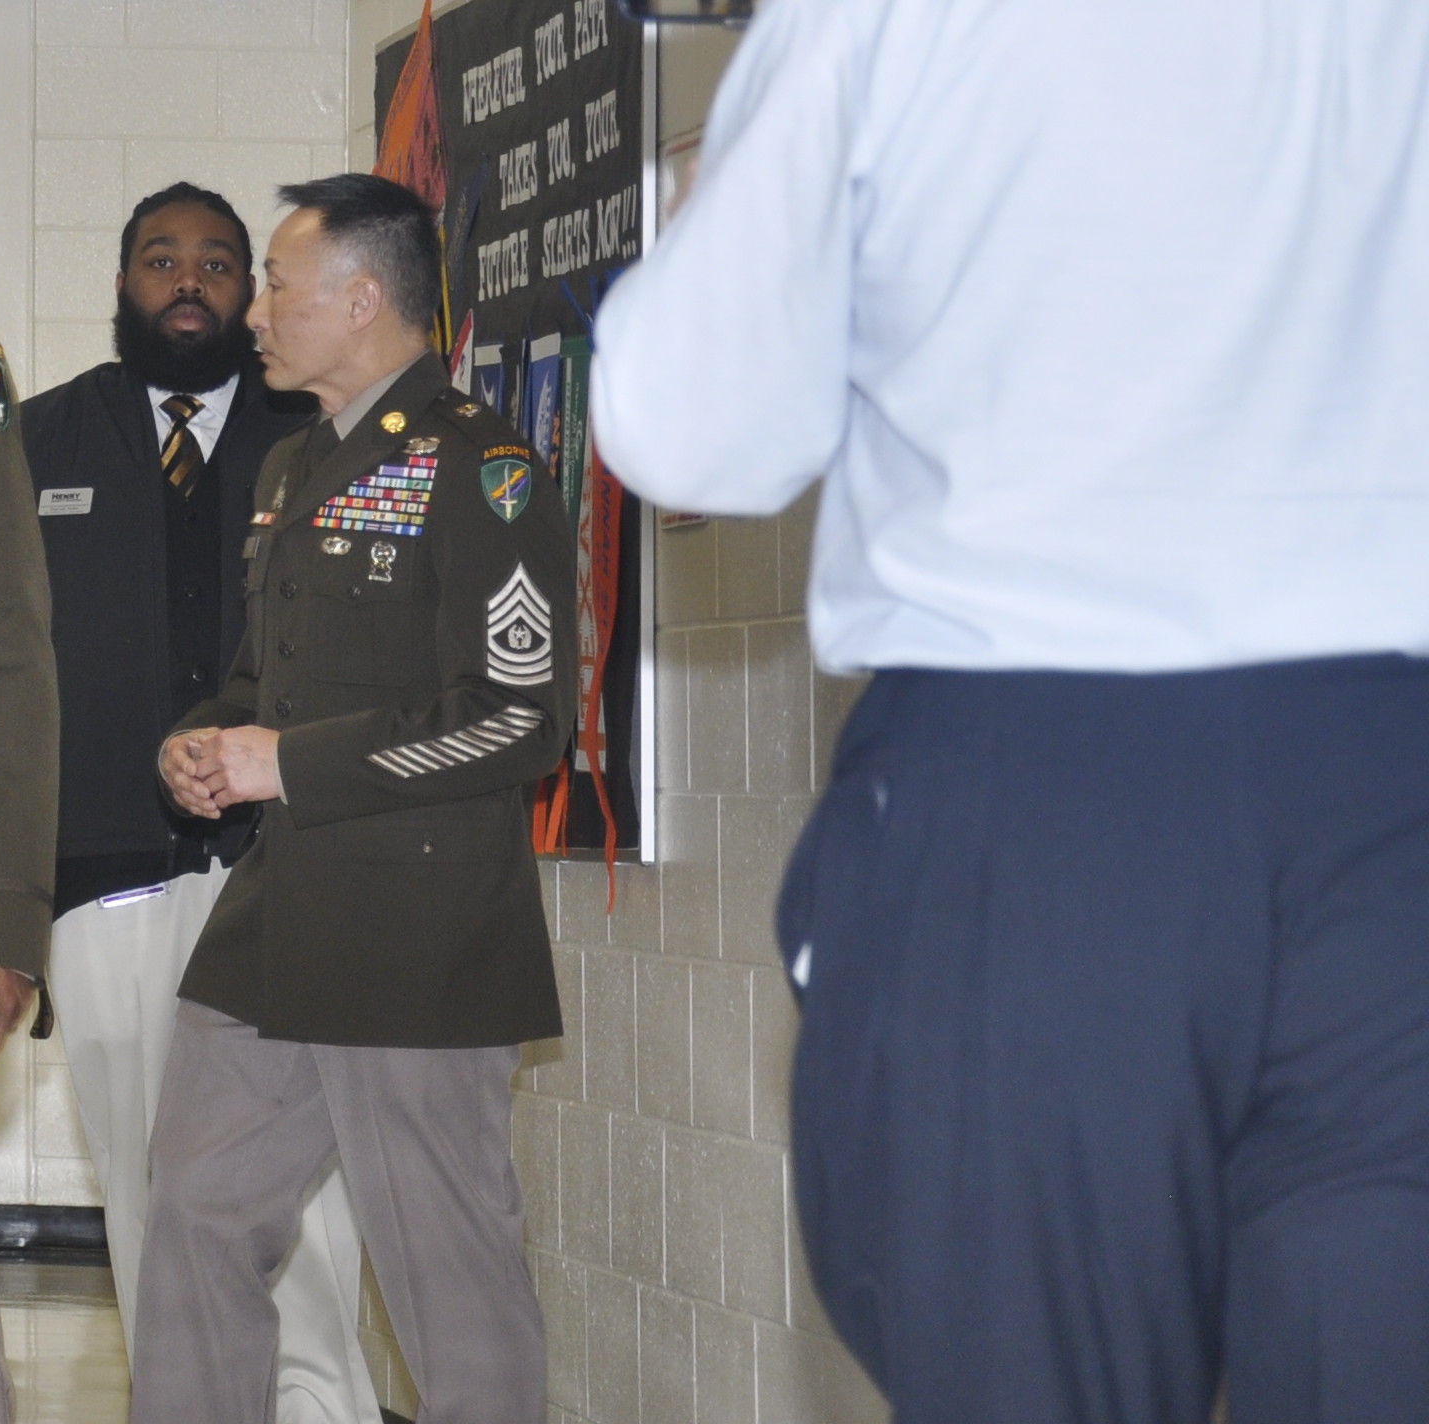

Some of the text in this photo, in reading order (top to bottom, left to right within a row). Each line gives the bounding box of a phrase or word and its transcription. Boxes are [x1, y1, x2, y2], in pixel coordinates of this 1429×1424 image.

[462, 45, 526, 127] WHEREVER
[534, 12, 568, 86] YOUR
[498, 88, 621, 211] TAKES YOU, YOUR
[477, 228, 529, 302] FUTURE
[541, 207, 591, 279] STARTS
[483, 444, 531, 461] AIRBORNE
